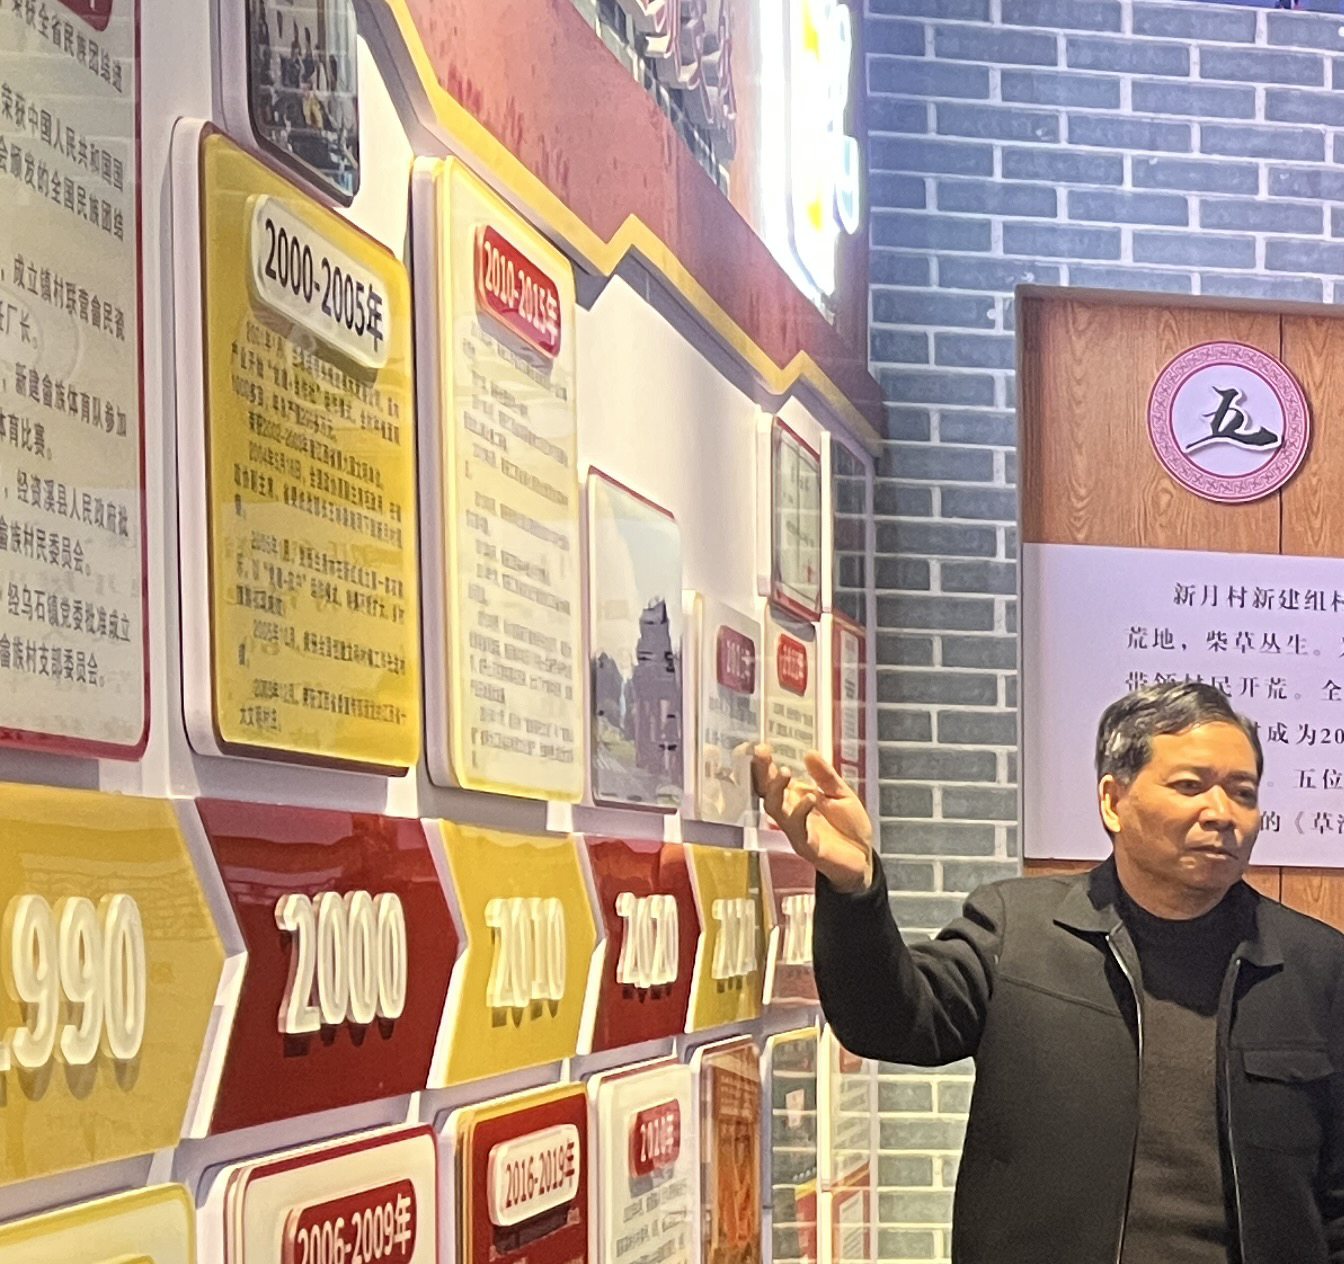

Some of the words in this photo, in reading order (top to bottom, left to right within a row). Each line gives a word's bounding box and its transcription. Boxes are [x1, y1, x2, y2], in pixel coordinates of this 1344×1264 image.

[265, 218, 383, 352] 2000-2005年
[0, 893, 146, 1071] 990
[275, 891, 407, 1034] 2000
[484, 897, 566, 1007] 2010
[616, 892, 679, 988] 2020
[506, 1138, 575, 1208] 2016-2019年
